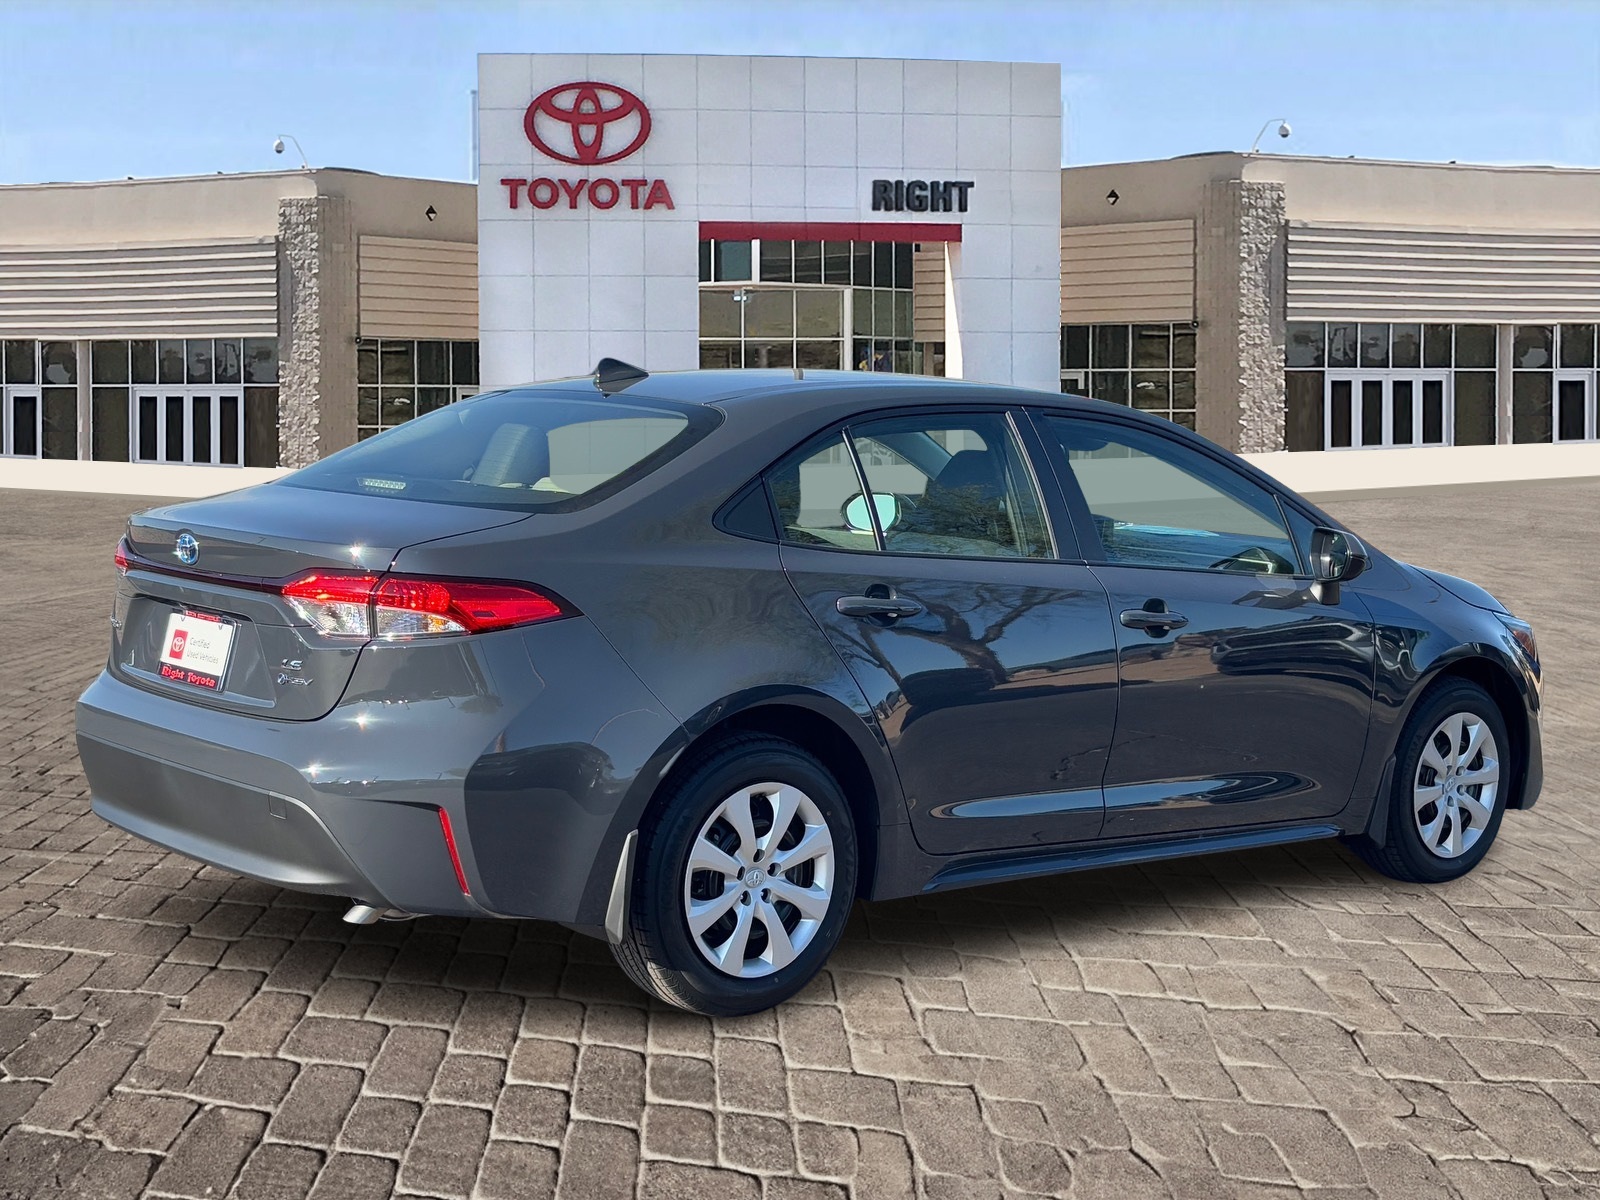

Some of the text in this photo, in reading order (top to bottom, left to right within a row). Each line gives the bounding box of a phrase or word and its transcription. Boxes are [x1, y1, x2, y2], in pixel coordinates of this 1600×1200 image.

[500, 178, 675, 210] TOYOTA
[872, 179, 975, 212] RIGHT
[189, 637, 210, 649] Certified
[187, 648, 219, 664] Used Vehicles
[280, 658, 303, 671] LE
[161, 665, 216, 687] Right Toyota
